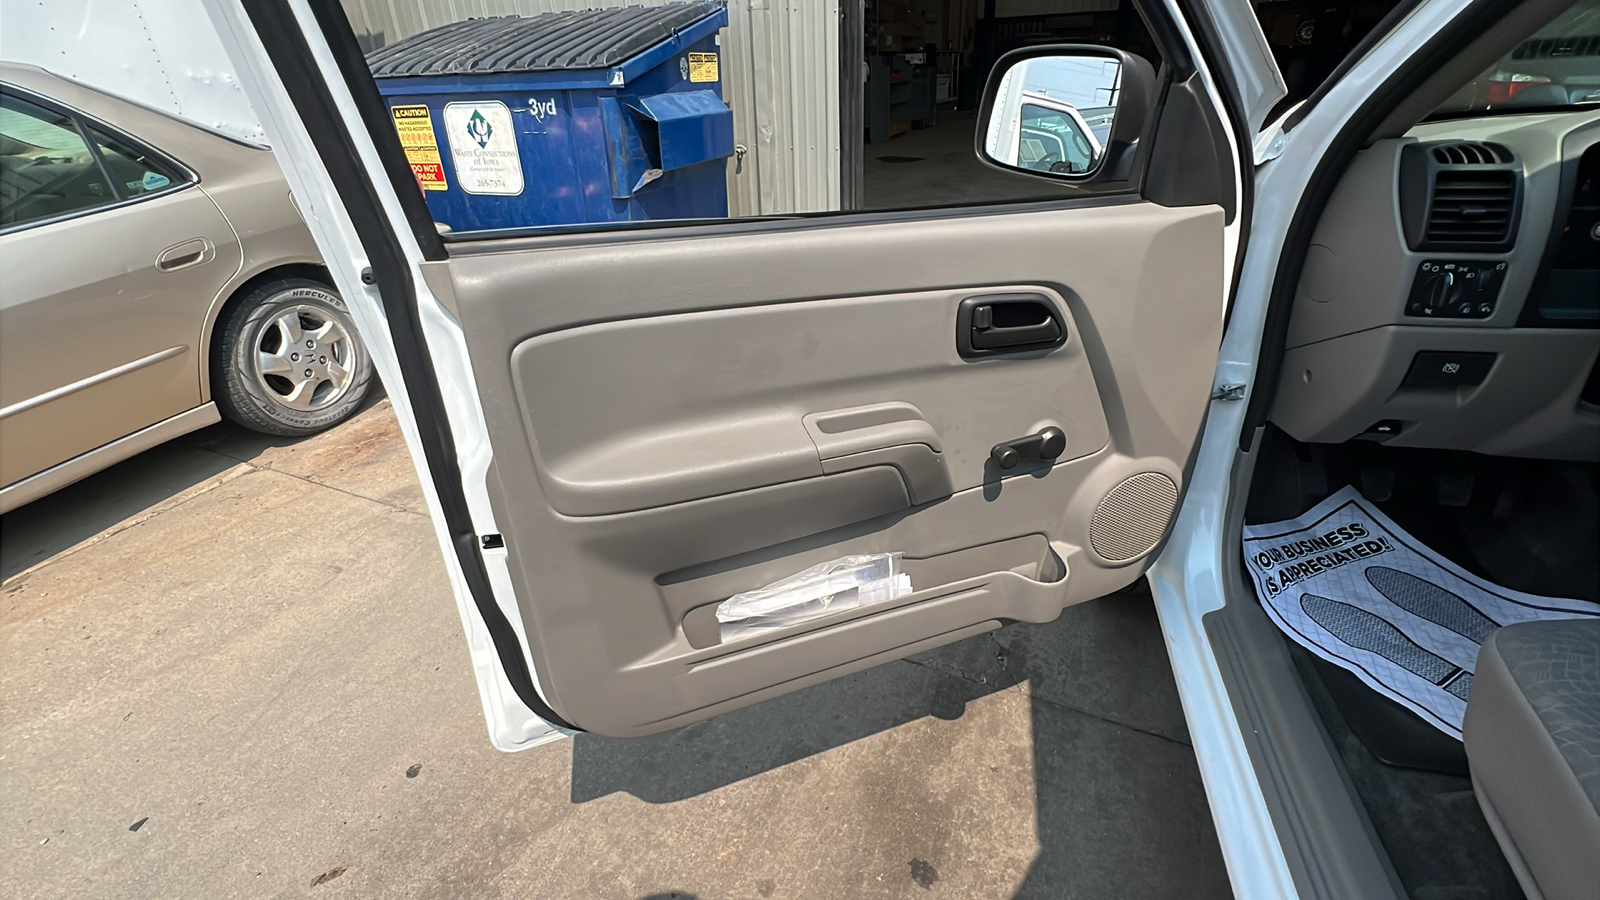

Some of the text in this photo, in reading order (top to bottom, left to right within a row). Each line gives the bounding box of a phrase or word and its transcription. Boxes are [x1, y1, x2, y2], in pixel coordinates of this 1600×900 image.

[400, 108, 427, 118] CAUTION
[528, 98, 557, 119] 3yd
[473, 157, 481, 166] of
[413, 165, 438, 173] DO NOT
[418, 172, 438, 180] PARK
[292, 290, 342, 307] HERCULES
[1251, 522, 1369, 571] YOUR BUSINESS
[1266, 536, 1395, 598] IS APPRECIATED!
